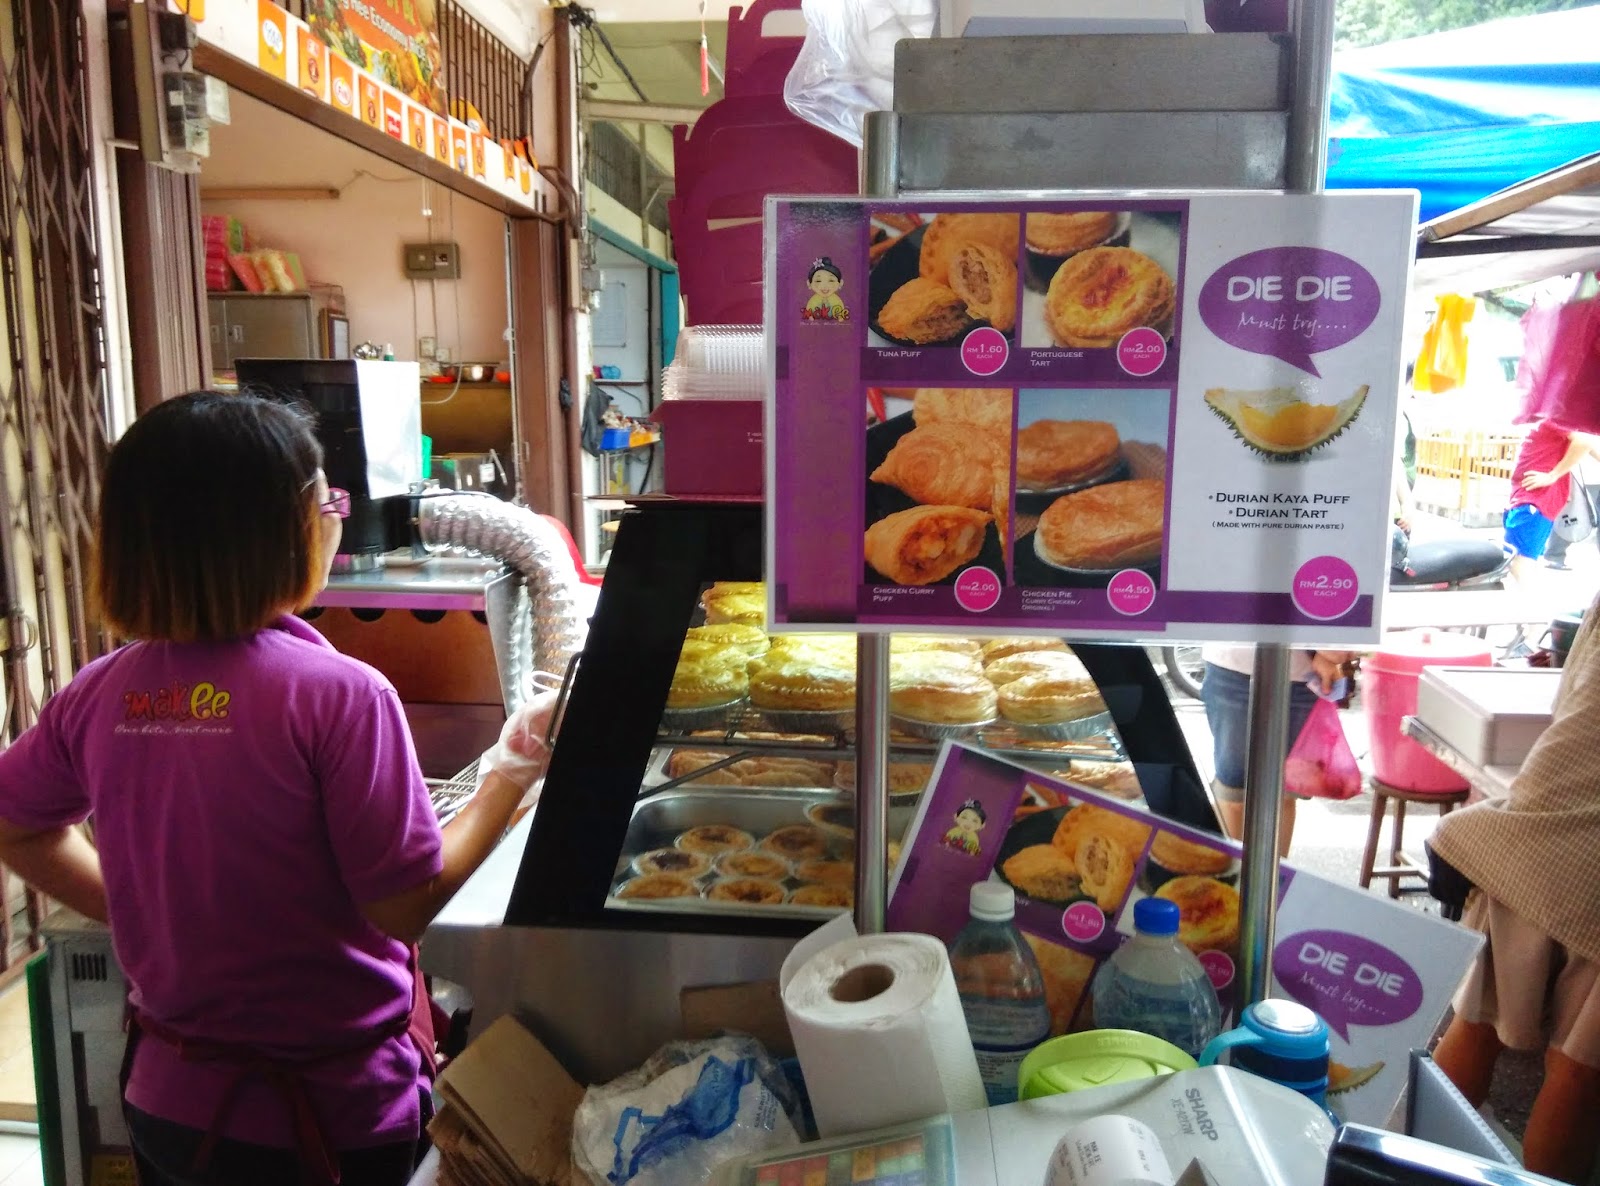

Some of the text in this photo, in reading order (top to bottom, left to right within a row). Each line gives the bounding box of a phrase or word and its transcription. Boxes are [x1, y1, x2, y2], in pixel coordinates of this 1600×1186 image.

[1227, 275, 1352, 302] DIE DIE
[1237, 312, 1286, 331] Must
[878, 350, 899, 358] TUNA
[1030, 351, 1084, 359] PORTUGUESE
[1216, 492, 1350, 504] DURIAN KAYA PUFF
[1235, 507, 1328, 519] DURIAN TART
[908, 587, 935, 595] CURRY
[1022, 590, 1057, 598] CHICKEN
[1298, 941, 1404, 997] DIE DIE
[1184, 1087, 1219, 1141] SHARP
